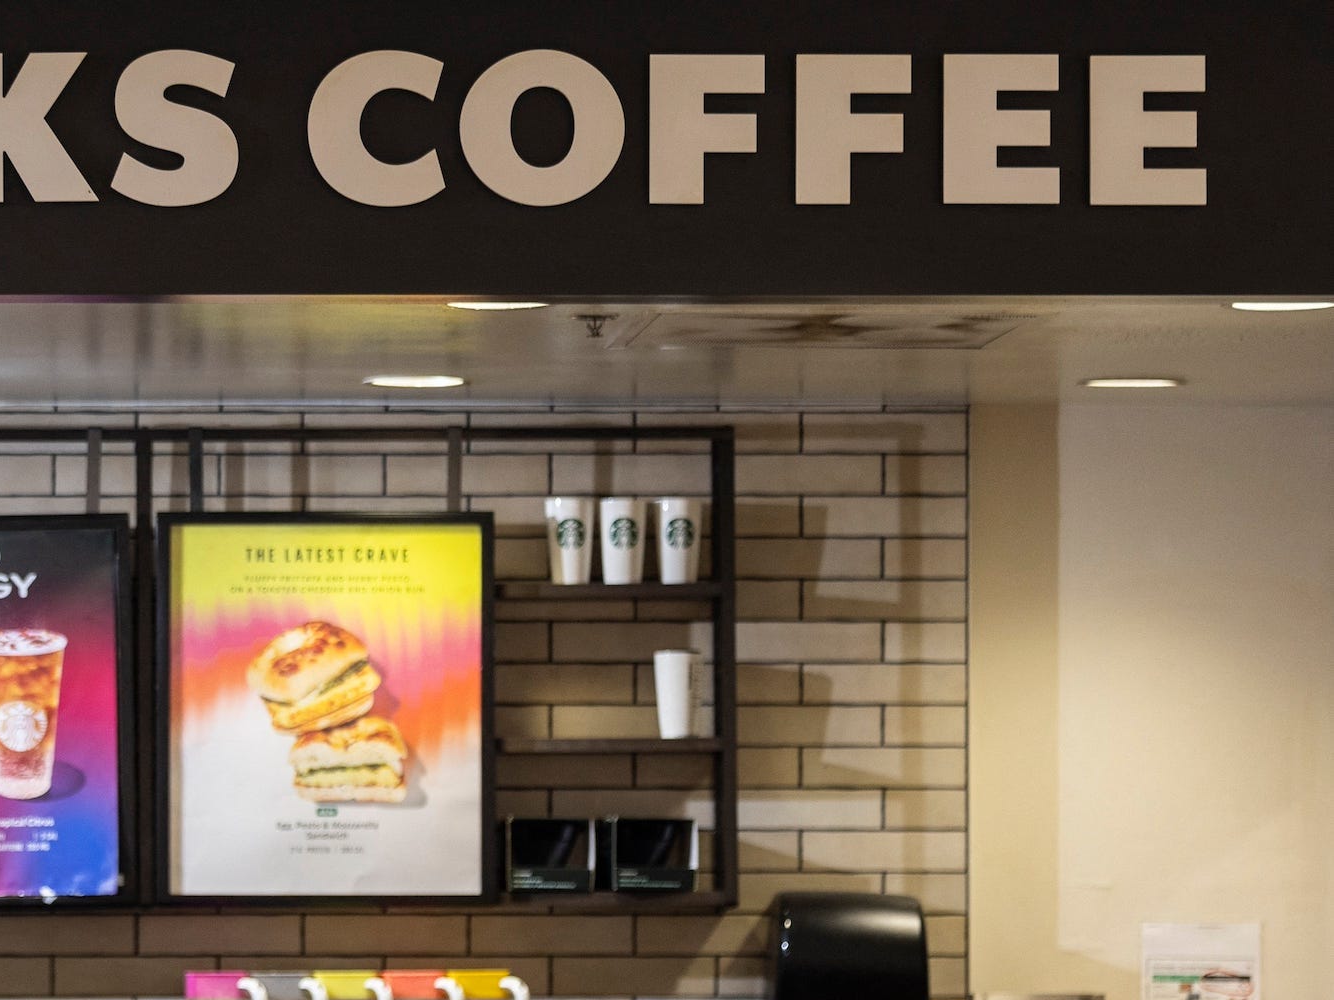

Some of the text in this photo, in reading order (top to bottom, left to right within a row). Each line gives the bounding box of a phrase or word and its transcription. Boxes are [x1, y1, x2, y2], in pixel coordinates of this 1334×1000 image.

[307, 48, 1207, 208] COFFEE
[246, 548, 409, 563] THE LATEST CRAVE
